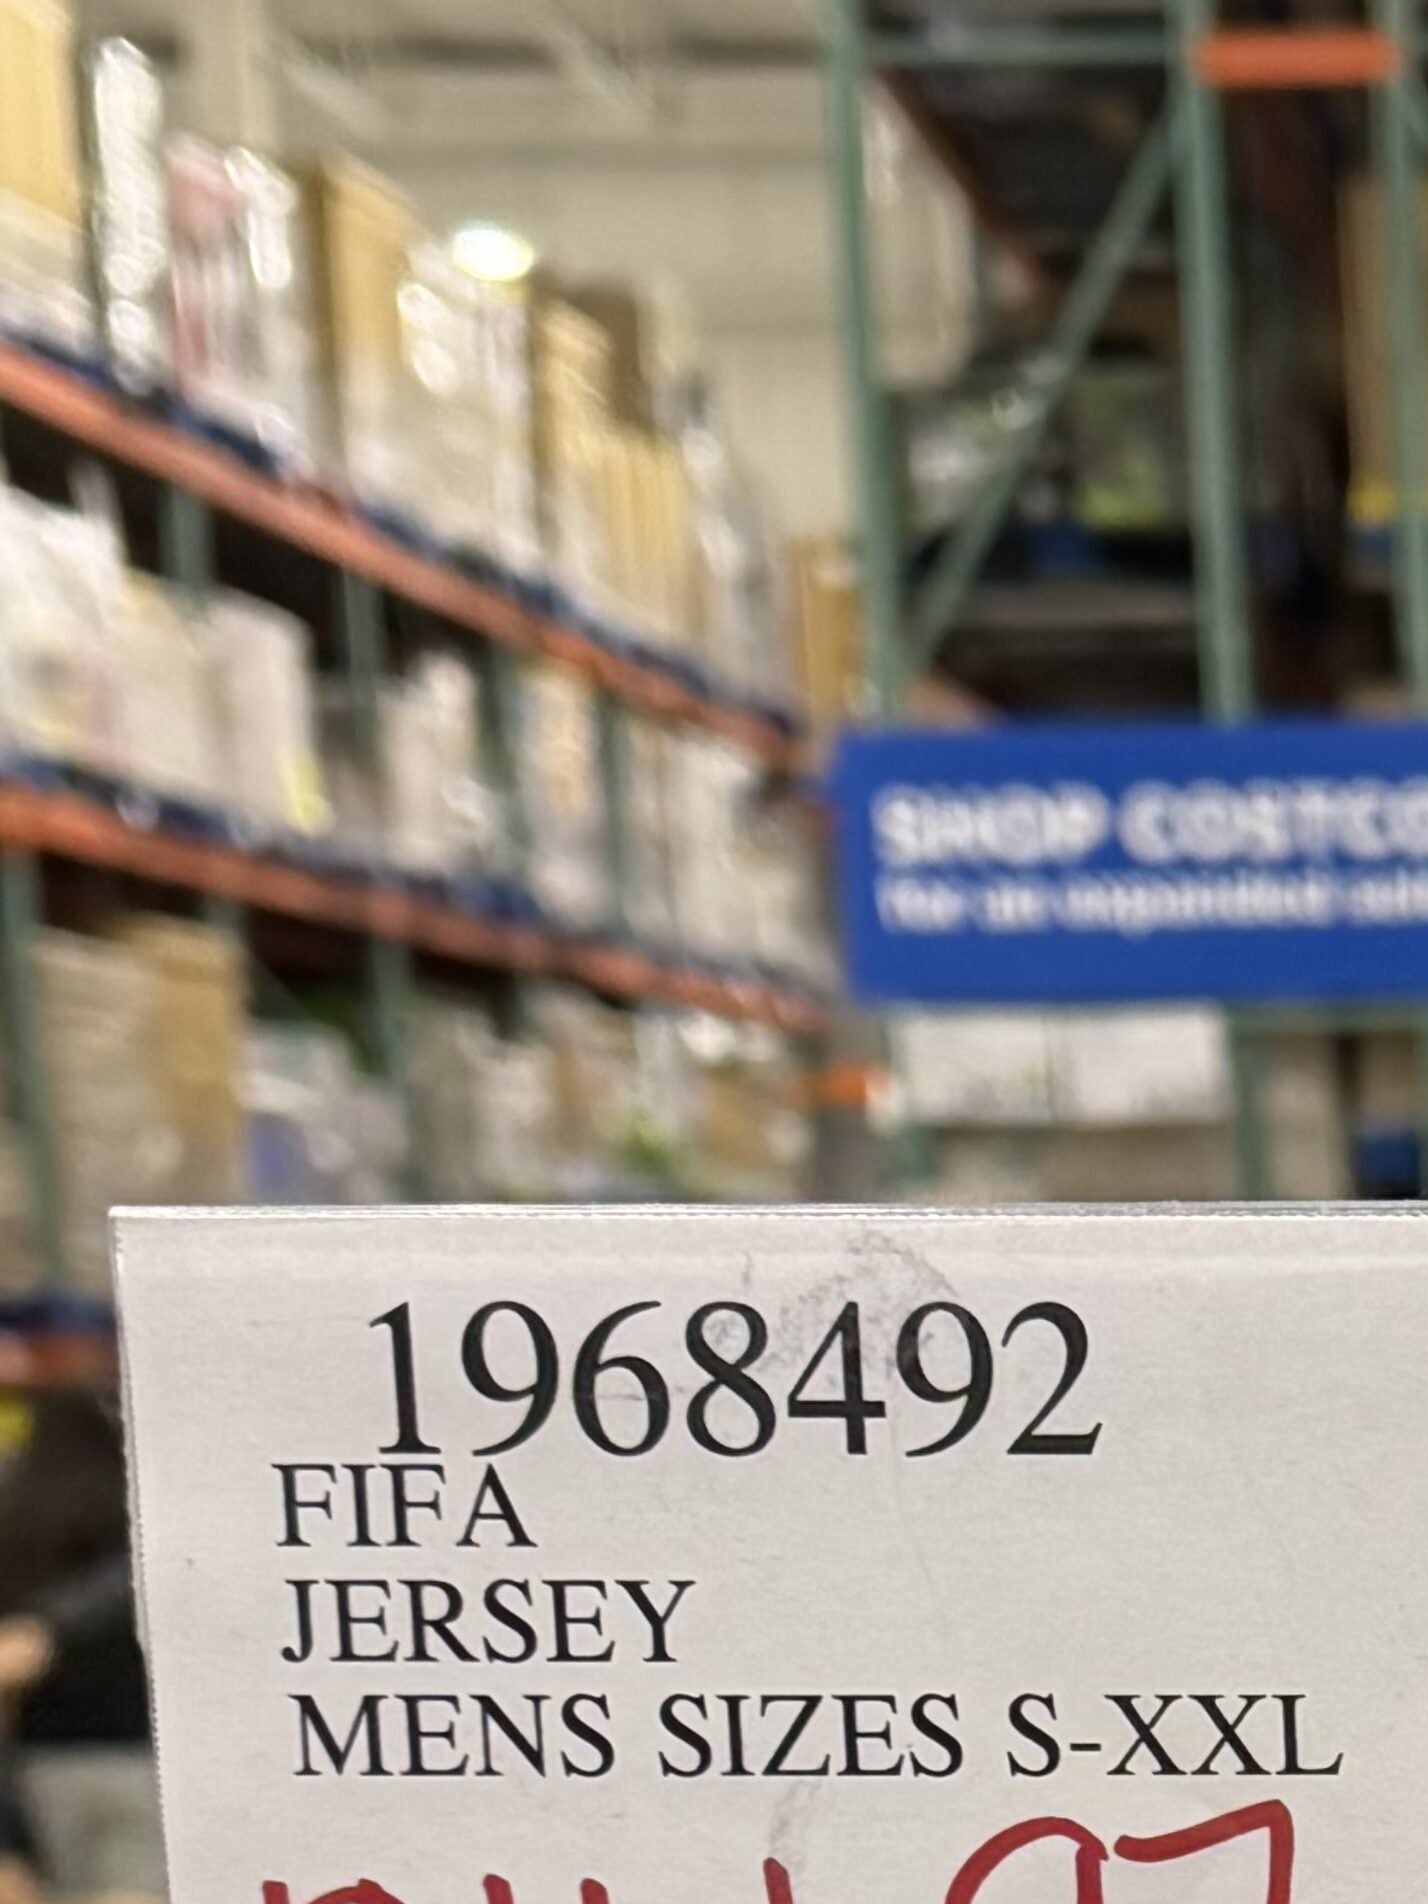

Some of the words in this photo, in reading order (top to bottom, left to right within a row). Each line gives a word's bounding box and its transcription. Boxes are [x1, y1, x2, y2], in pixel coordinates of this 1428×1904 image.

[872, 781, 1110, 866] SHOP
[368, 1299, 1104, 1459] 1968492
[270, 1462, 539, 1549] FIFA
[280, 1577, 697, 1665] JERSEY
[288, 1692, 616, 1779] MENS
[657, 1692, 964, 1779] SIZES
[1006, 1692, 1344, 1778] S-XXL
